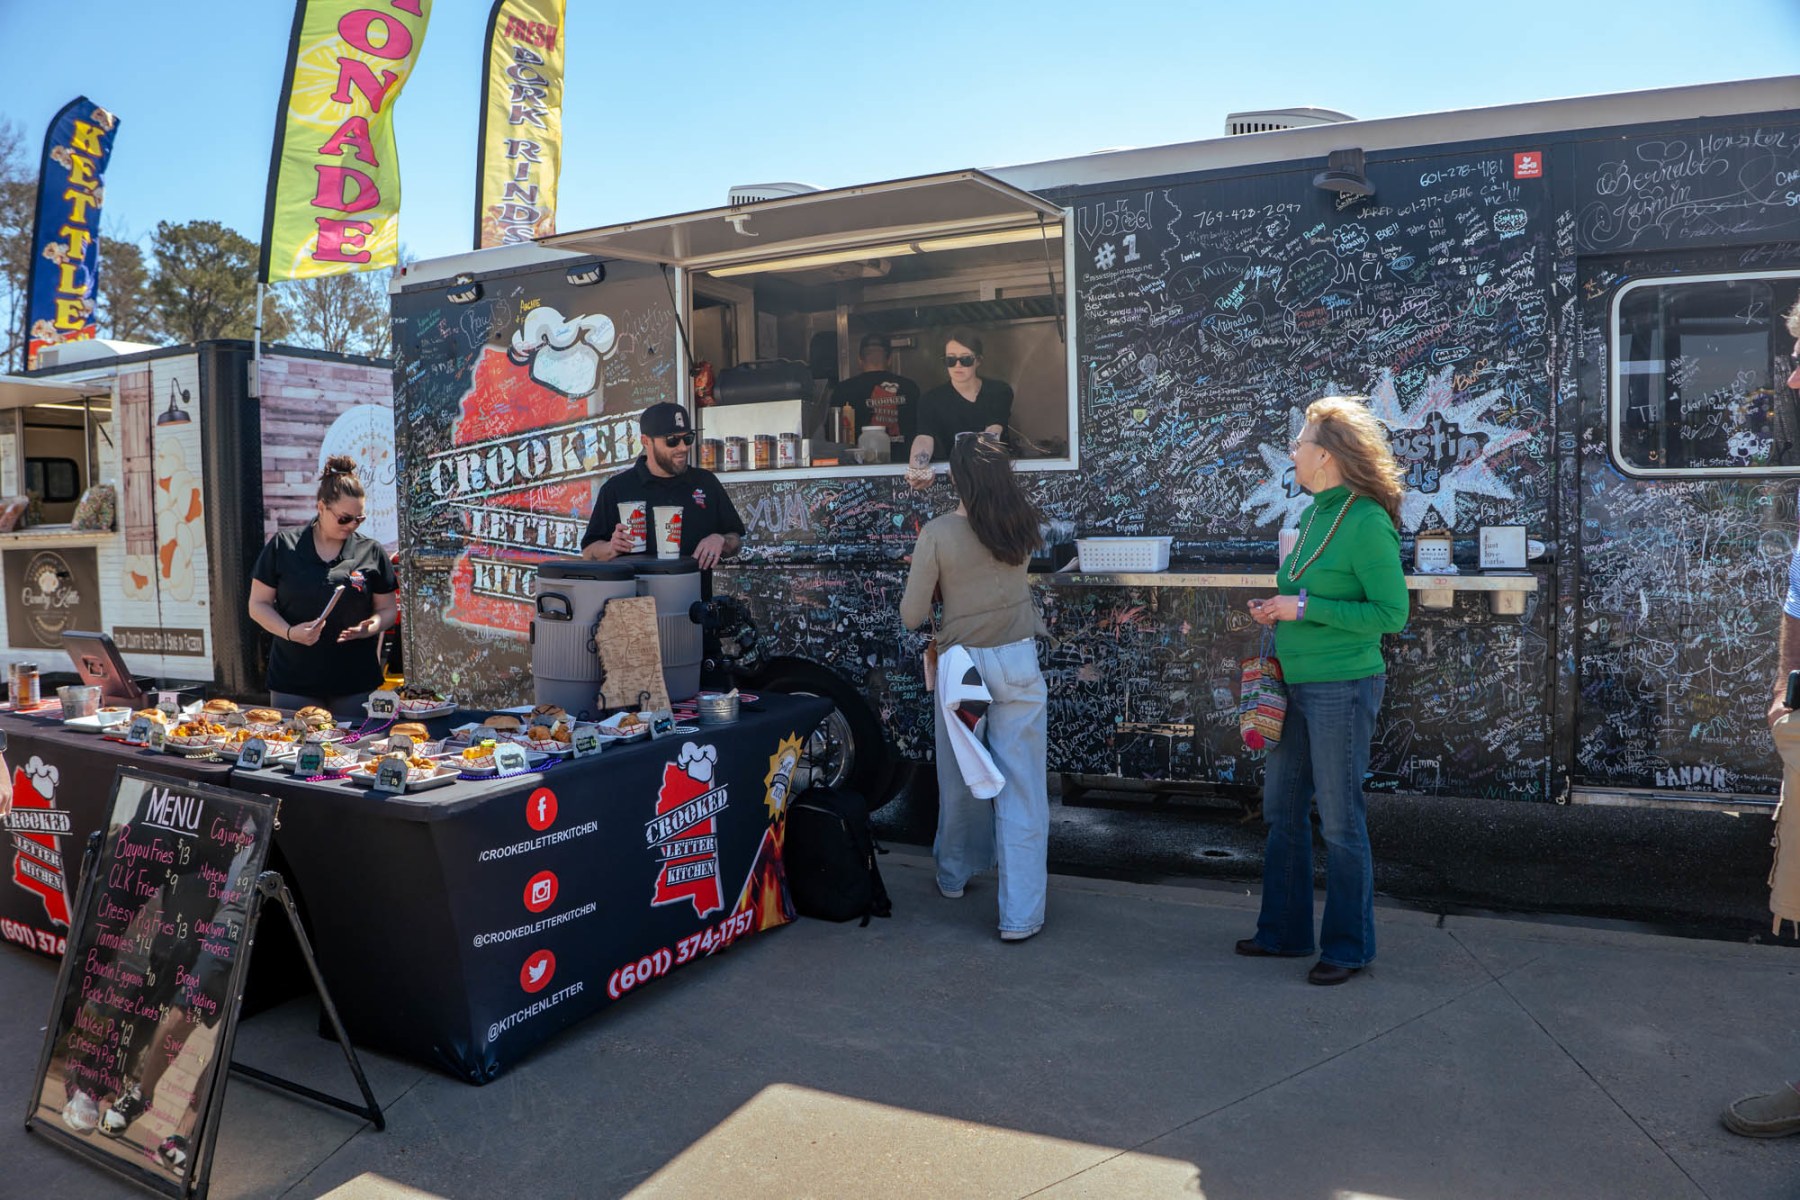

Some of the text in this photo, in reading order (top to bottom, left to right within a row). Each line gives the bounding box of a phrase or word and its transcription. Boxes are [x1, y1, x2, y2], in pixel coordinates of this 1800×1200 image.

[504, 15, 558, 52] FRESH
[505, 46, 549, 130] PORK
[311, 0, 422, 263] ONADE
[502, 138, 542, 246] RINDS
[54, 120, 106, 331] KETTLE
[1077, 191, 1154, 252] Voted
[430, 419, 643, 497] CROOKED
[1392, 417, 1480, 463] ustin
[470, 509, 588, 557] LETTE
[746, 491, 809, 532] YUM
[145, 787, 203, 830] MENU
[646, 788, 729, 844] CROOKED
[114, 824, 149, 867] Bayou
[150, 838, 175, 865] Fries
[210, 817, 238, 847] Cajun
[478, 820, 598, 862] /CROOKEDLETTERKITCHEN
[665, 839, 715, 859] LETTER
[20, 857, 62, 889] KITCHEN
[108, 863, 135, 892] CLK
[135, 869, 159, 898] Fries
[667, 861, 715, 883] KITCHEN
[97, 893, 135, 927] Cheesy
[151, 910, 175, 935] Fries
[473, 902, 597, 947] @CROOKEDLETTERKITCHEN
[95, 922, 135, 953] Tamales
[197, 938, 231, 958] Tenders
[608, 909, 754, 998] (601) 374-1757
[175, 964, 200, 988] Bread
[488, 981, 584, 1043] @KITCHENLETTER
